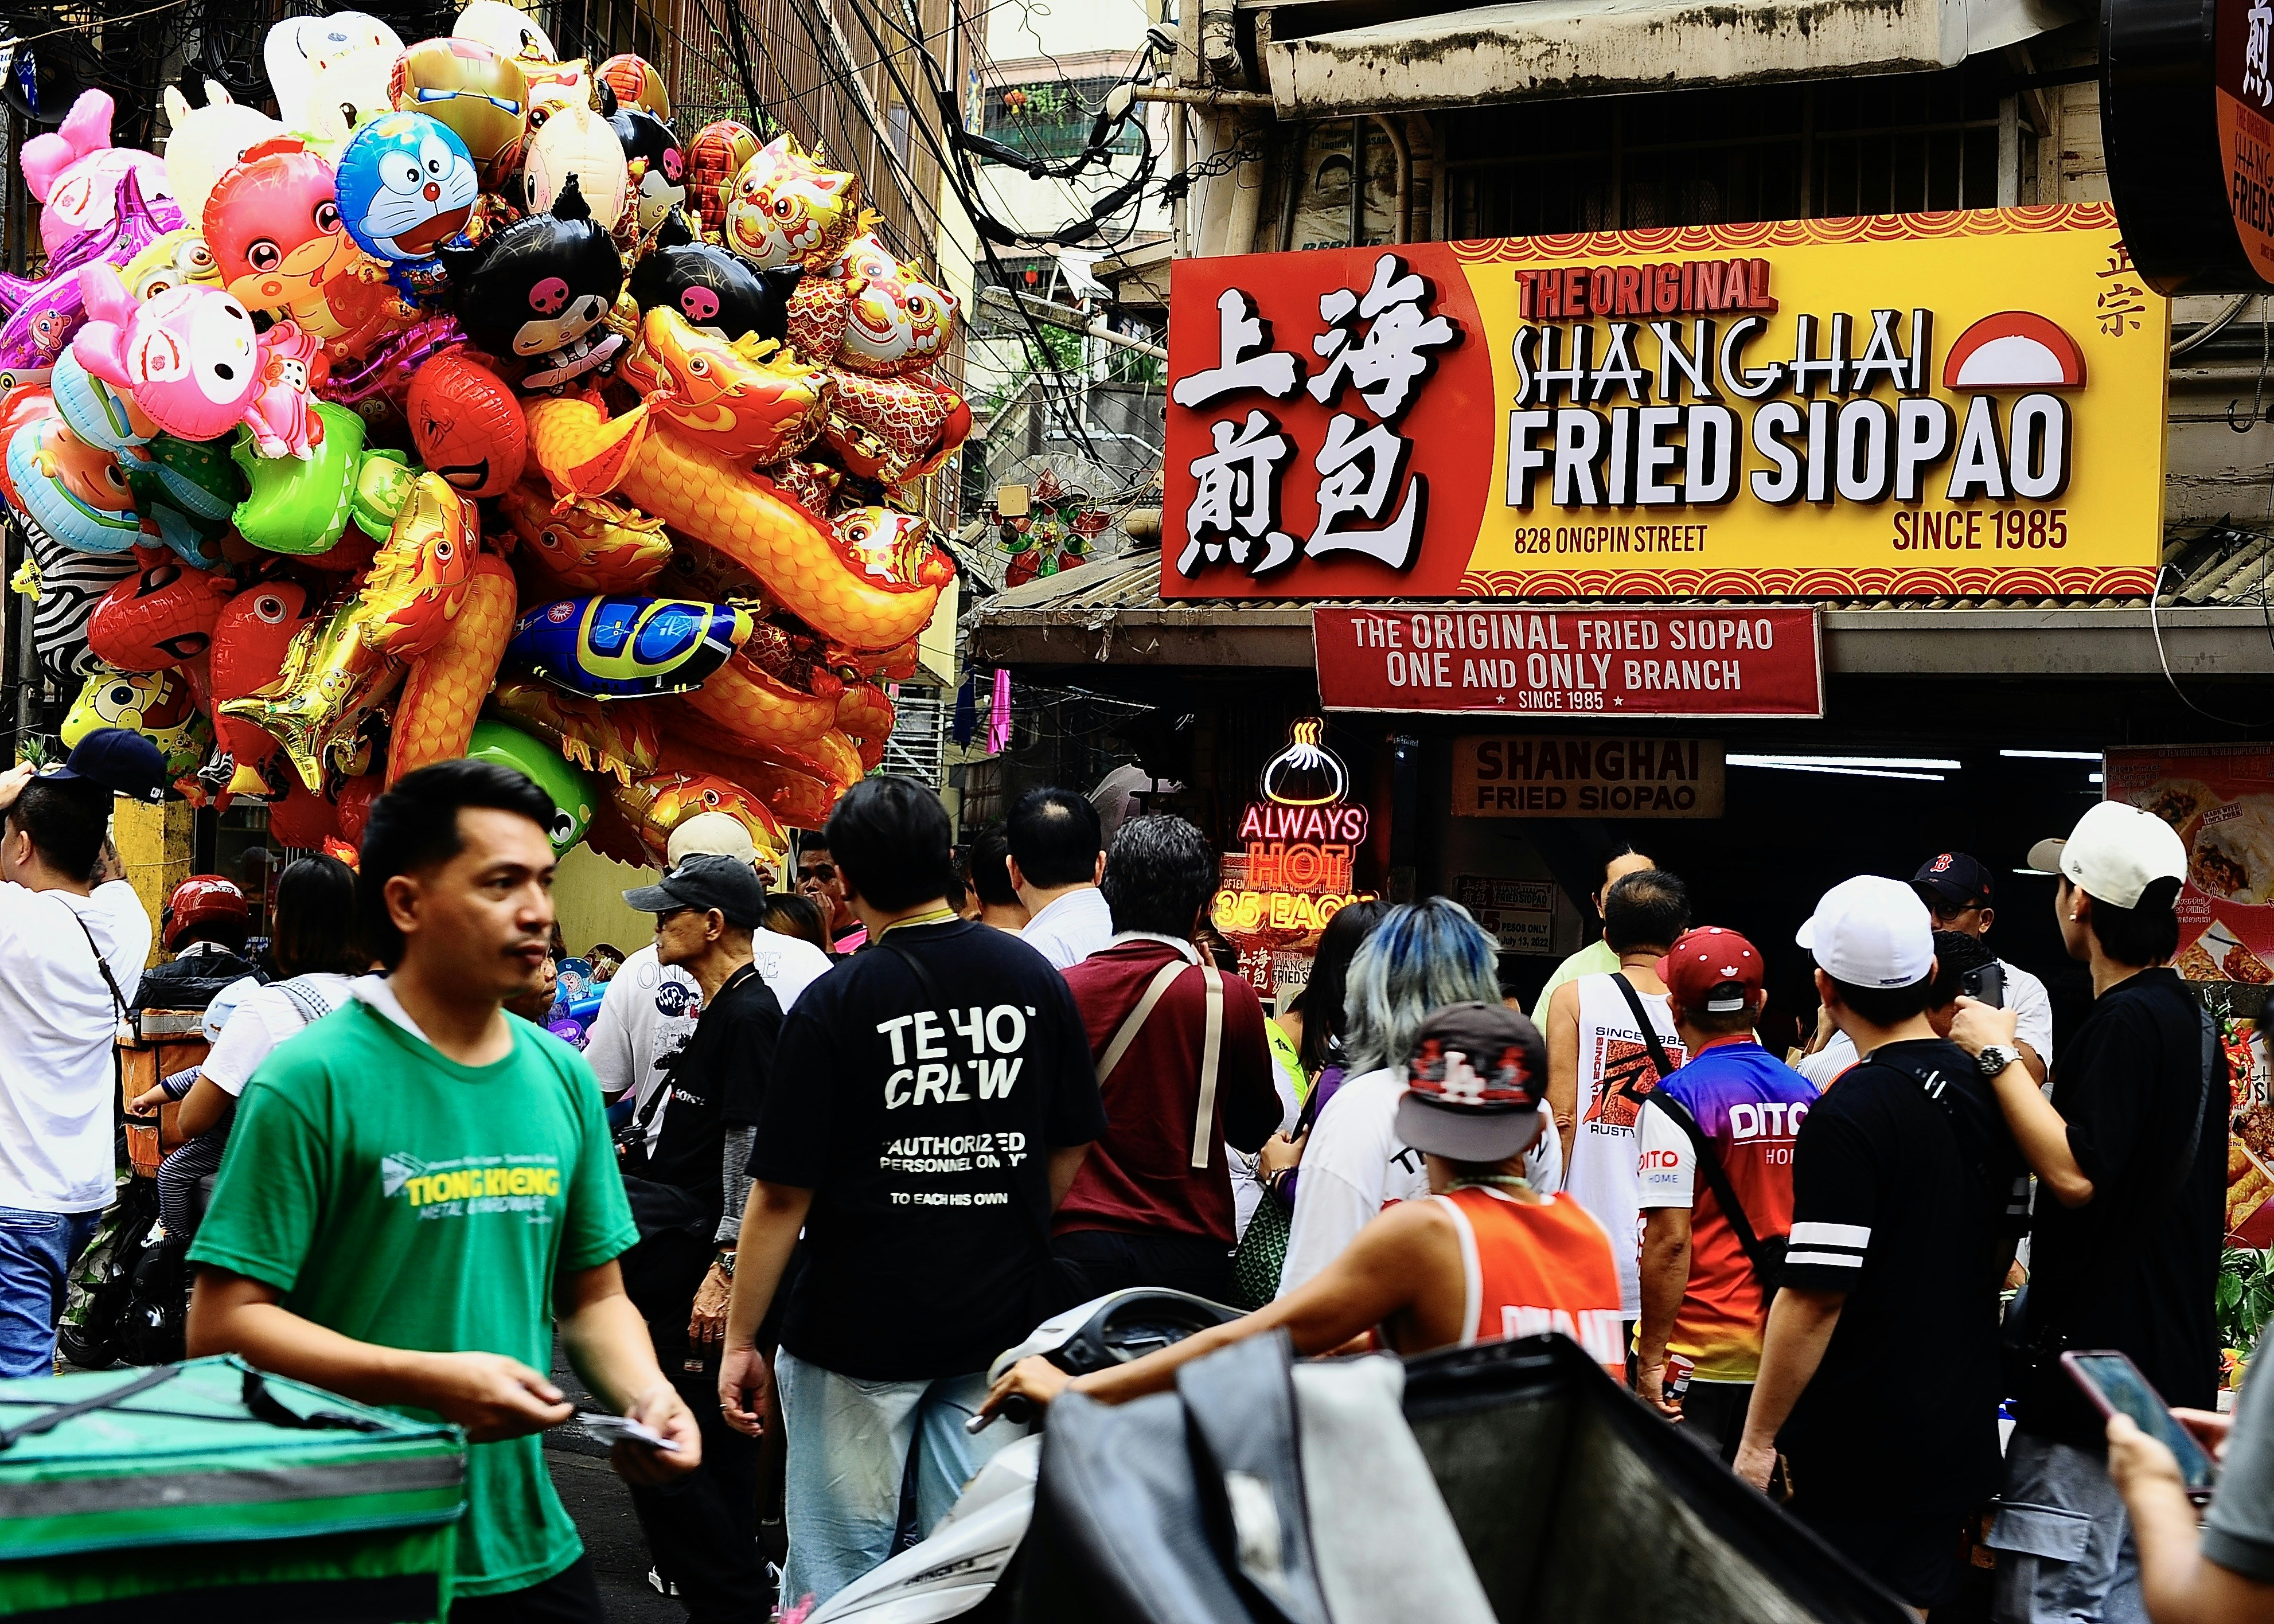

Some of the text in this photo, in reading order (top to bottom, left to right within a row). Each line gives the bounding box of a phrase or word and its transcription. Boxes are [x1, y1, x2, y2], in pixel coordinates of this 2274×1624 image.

[2246, 111, 2271, 147] ORIGINAL
[2233, 170, 2266, 233] FRIED
[1515, 257, 1778, 320] THE ORIGINAL
[1173, 253, 1462, 420] 上海
[1513, 307, 1934, 405] SHANGHAI
[1507, 392, 2071, 508] FRIED SIOPAO
[1176, 409, 1428, 576] 煎包
[1514, 525, 1708, 554] 828 ONGPIN STREET
[1892, 508, 2068, 551] SINCE 1985
[1351, 614, 1773, 651] THE ORIGINAL FRIED SIOPAO
[1387, 651, 1741, 691] ONE AND ONLY BRANCH
[1518, 690, 1604, 710] SINCE 1985
[1476, 739, 1699, 782] SHANGHAI
[2159, 748, 2179, 758] OFTEN
[2211, 748, 2232, 756] NEVER
[2233, 746, 2271, 756] DUPLICATED
[1477, 784, 1696, 811] FRIED SIOPAO
[2203, 804, 2240, 819] MADE WITH
[1241, 806, 1362, 841] ALWAYS
[2205, 810, 2241, 825] 100% PORK
[1250, 842, 1349, 890] HOT
[1929, 853, 1955, 873] B
[1223, 879, 1246, 890] OFTEN
[1214, 889, 1375, 930] 35 EAC
[1501, 922, 1526, 933] PESOS
[1528, 924, 1548, 934] ONLY
[1501, 935, 1517, 947] July
[1518, 937, 1529, 948] 13,
[1531, 938, 1548, 947] 2022
[1237, 946, 1272, 969] 上海
[1272, 951, 1304, 961] THE ORIGINAL
[1271, 969, 1301, 984] FRIED
[1596, 1026, 1643, 1041] SINCE
[1648, 1173, 1679, 1184] HOME
[890, 1192, 911, 1205] TO
[973, 1192, 1009, 1205] OWN
